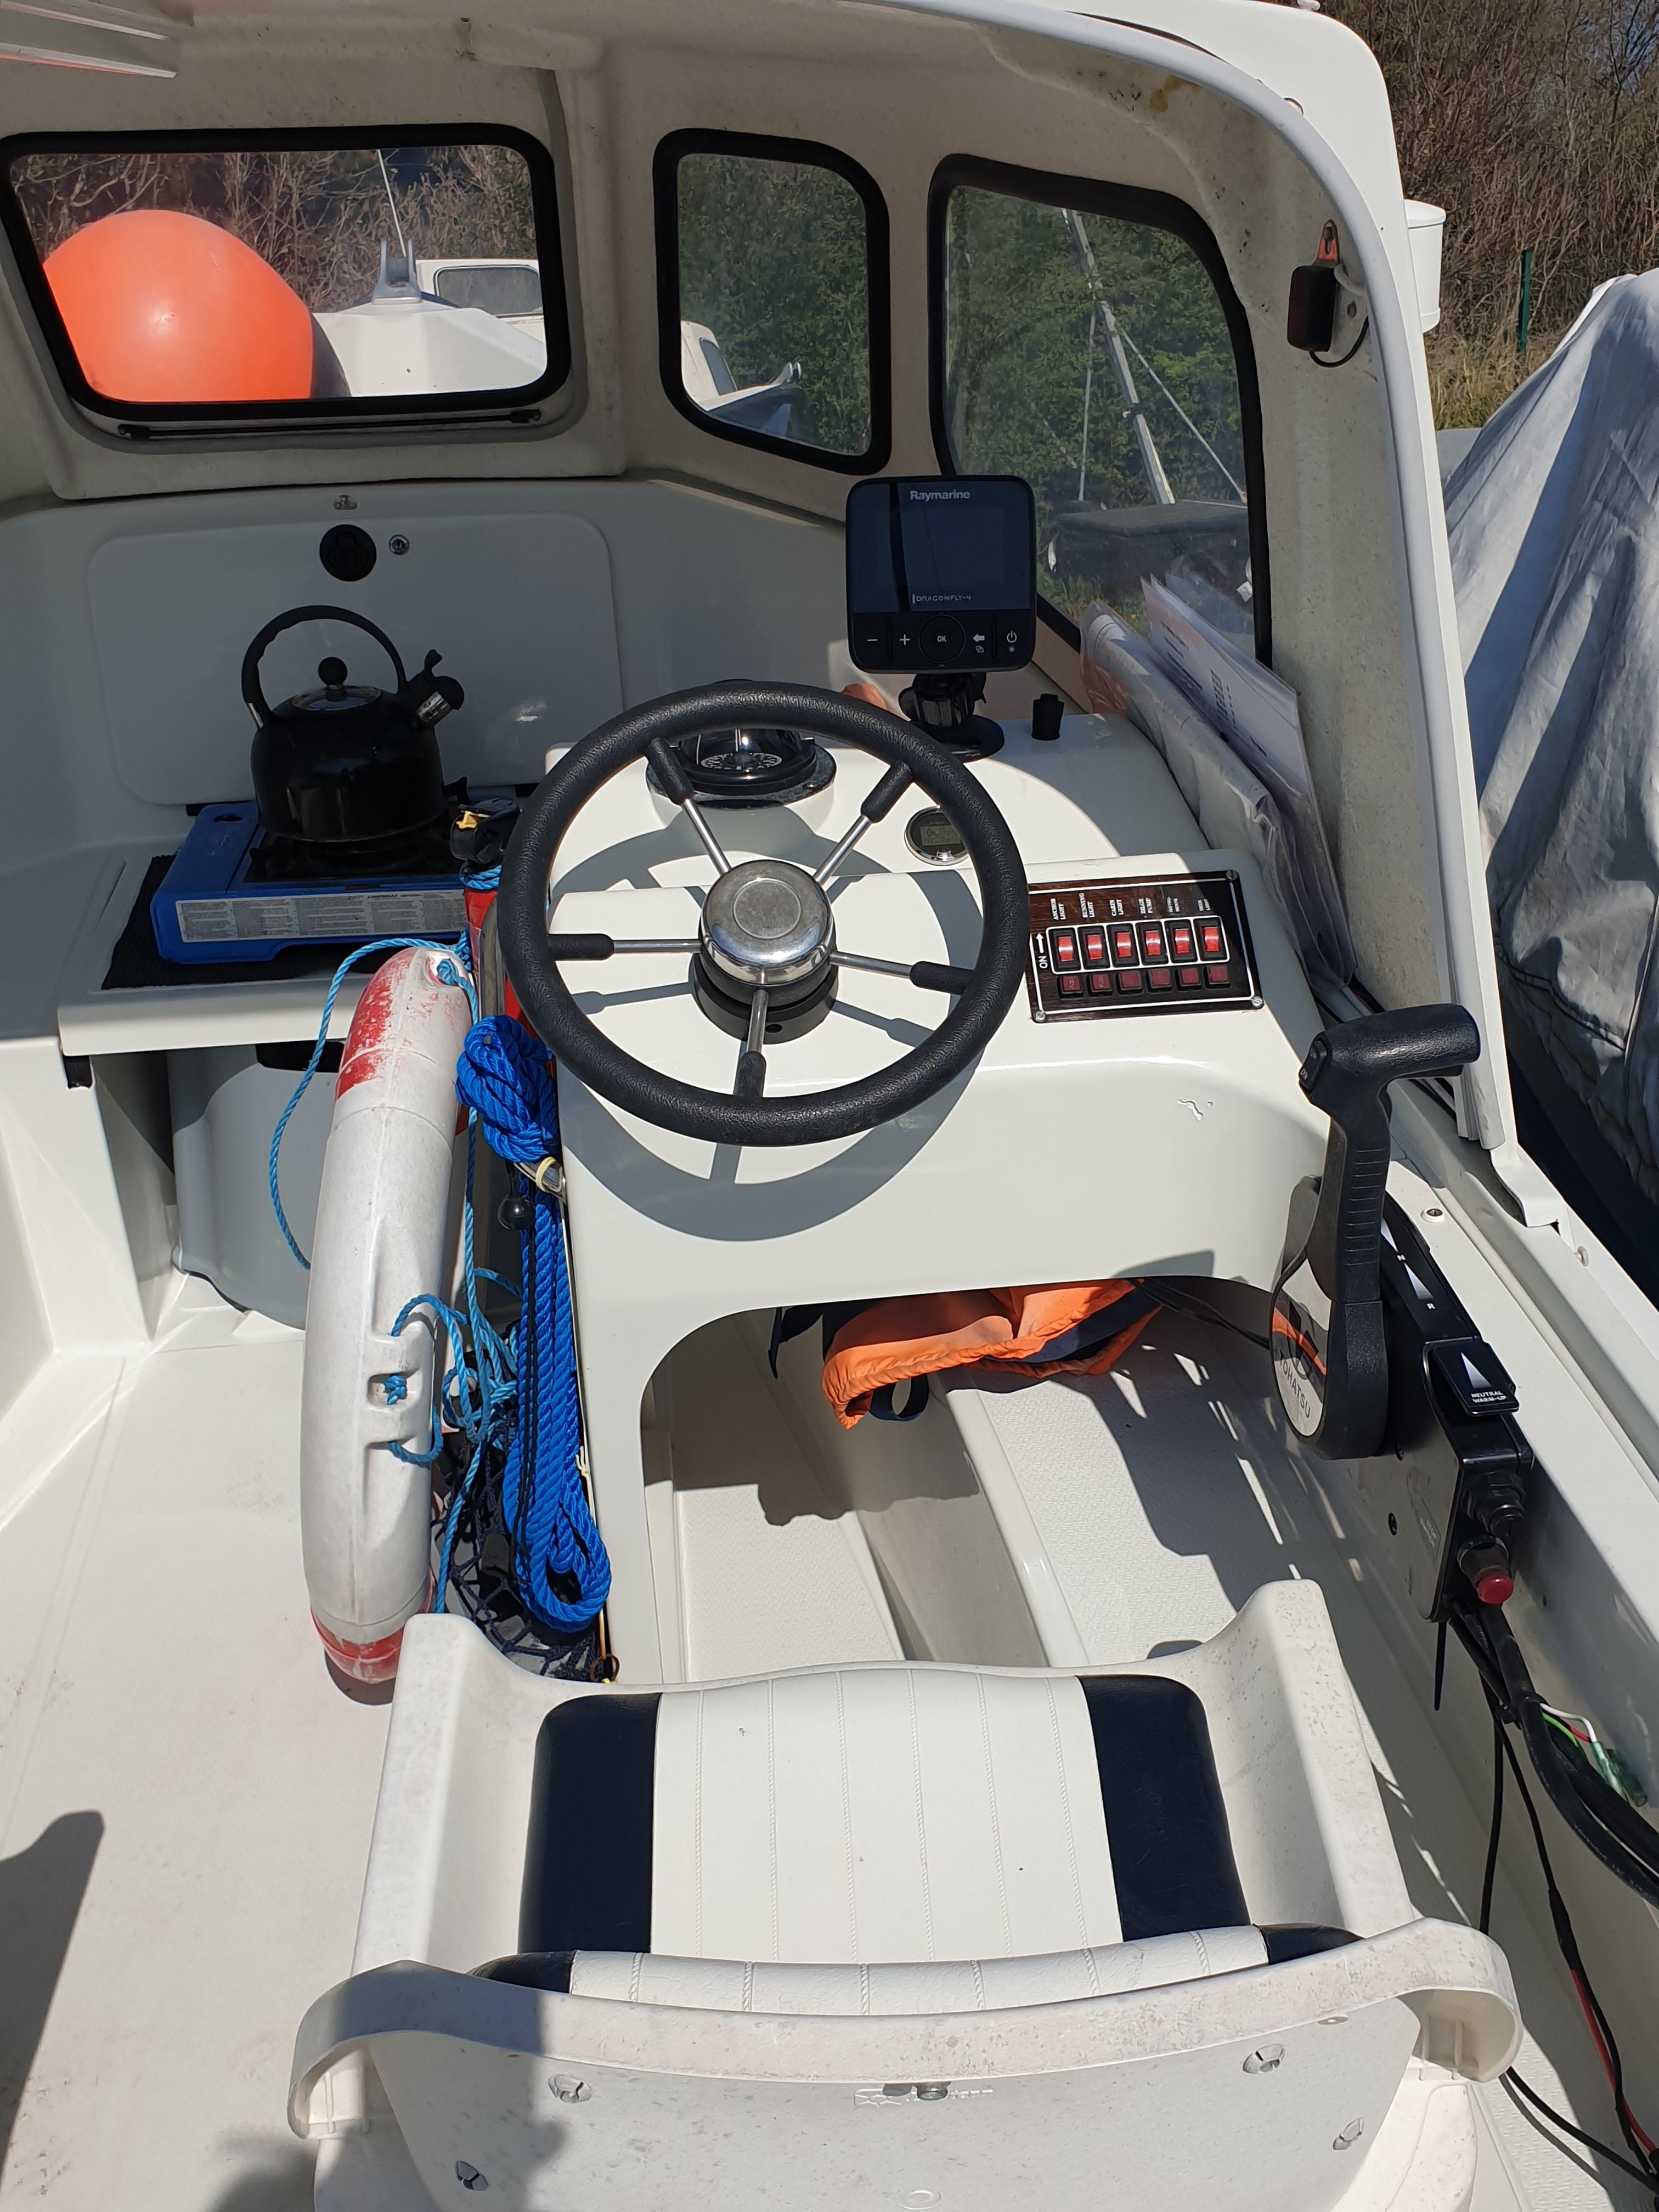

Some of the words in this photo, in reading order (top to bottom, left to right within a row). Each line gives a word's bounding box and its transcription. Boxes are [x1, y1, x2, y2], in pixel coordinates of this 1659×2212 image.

[910, 489, 970, 502] Raymarine
[1116, 899, 1124, 916] LIGHT
[1038, 956, 1048, 969] ON
[1279, 1350, 1311, 1418] TOHATSU
[1472, 1395, 1506, 1403] WARM-UP
